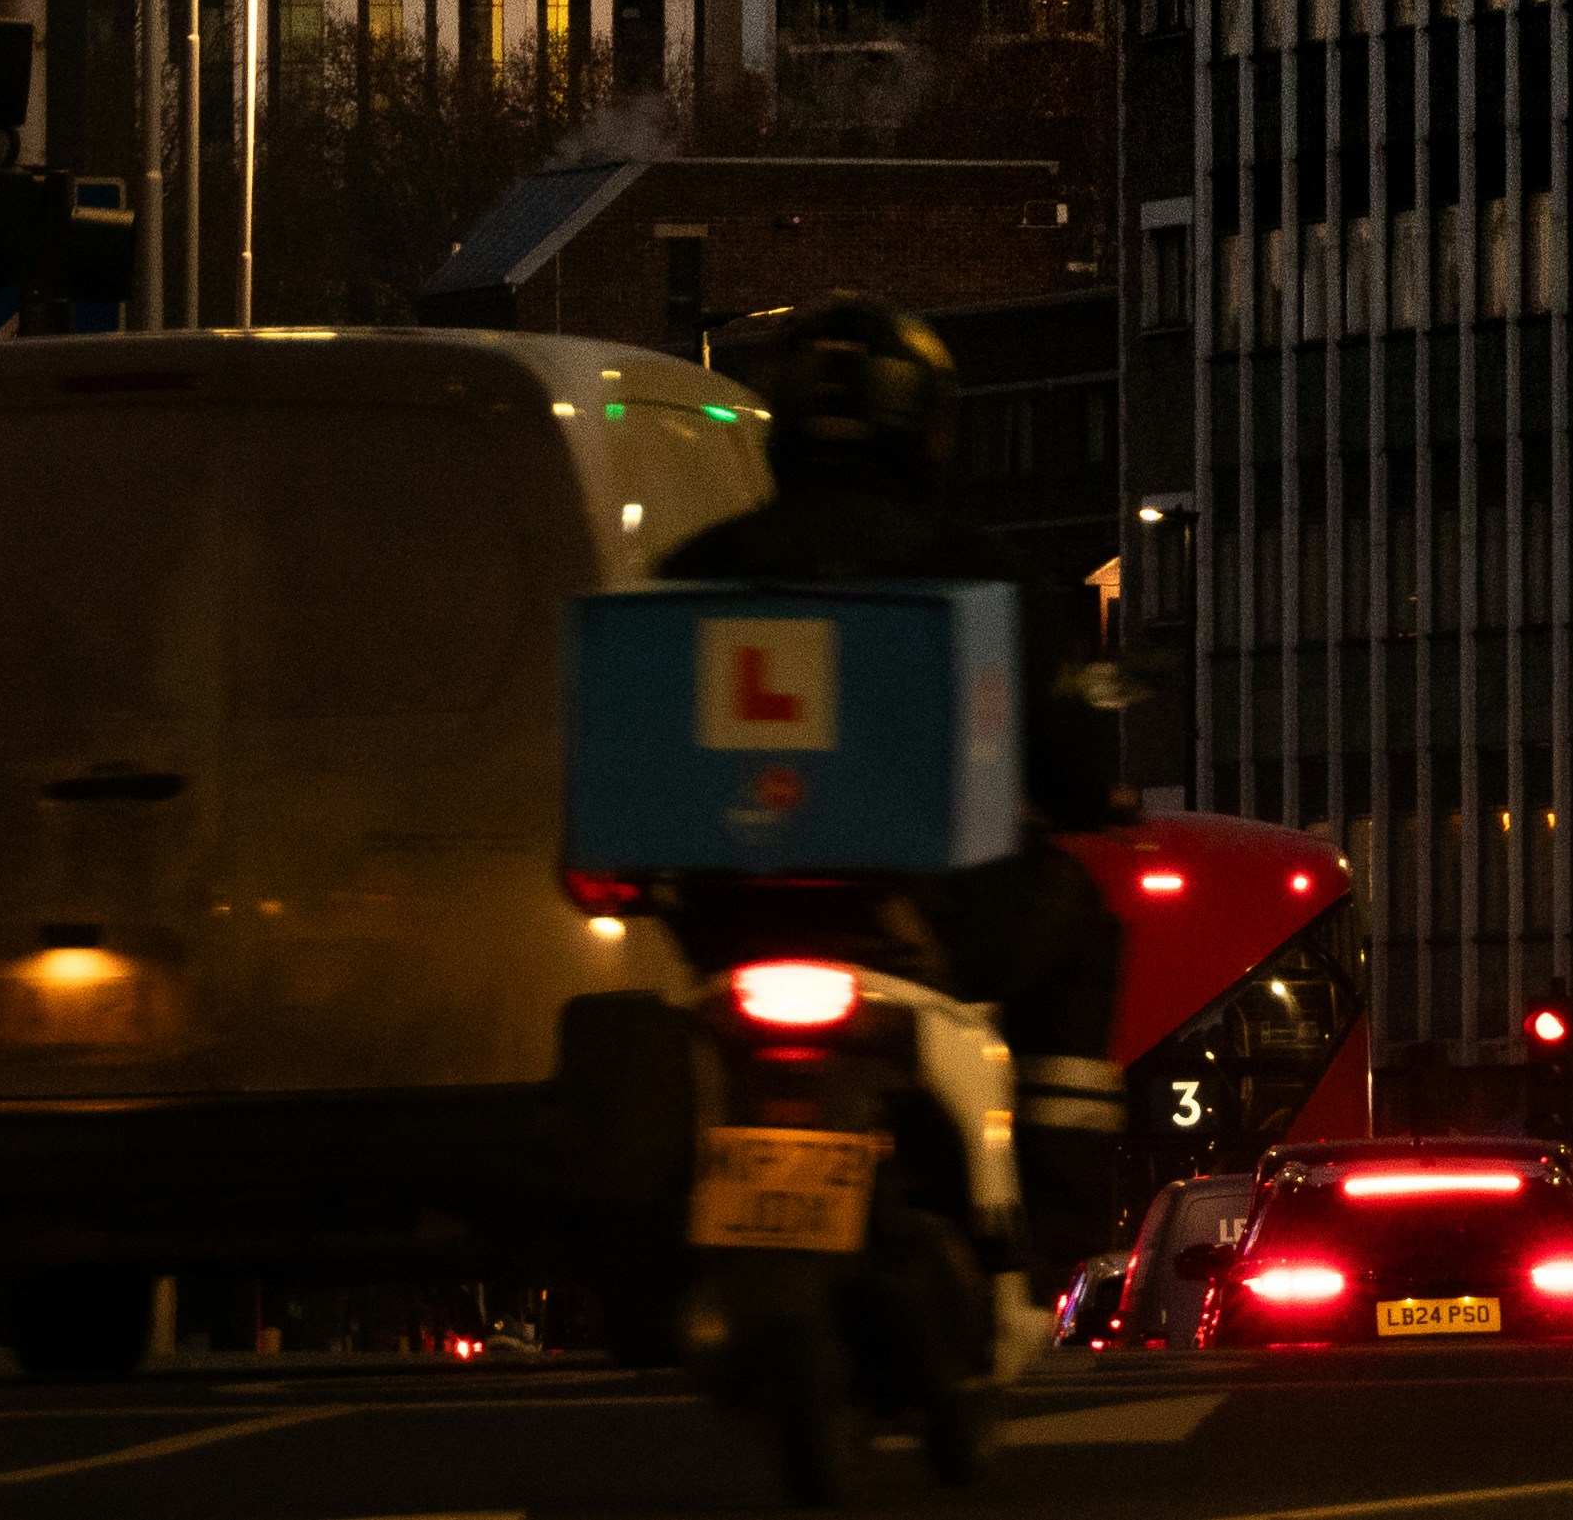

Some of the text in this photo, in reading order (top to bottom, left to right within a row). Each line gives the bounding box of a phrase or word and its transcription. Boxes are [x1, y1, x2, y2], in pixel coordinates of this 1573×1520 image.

[736, 646, 800, 721] L
[1171, 1080, 1203, 1127] 3
[1386, 1305, 1442, 1326] LB24
